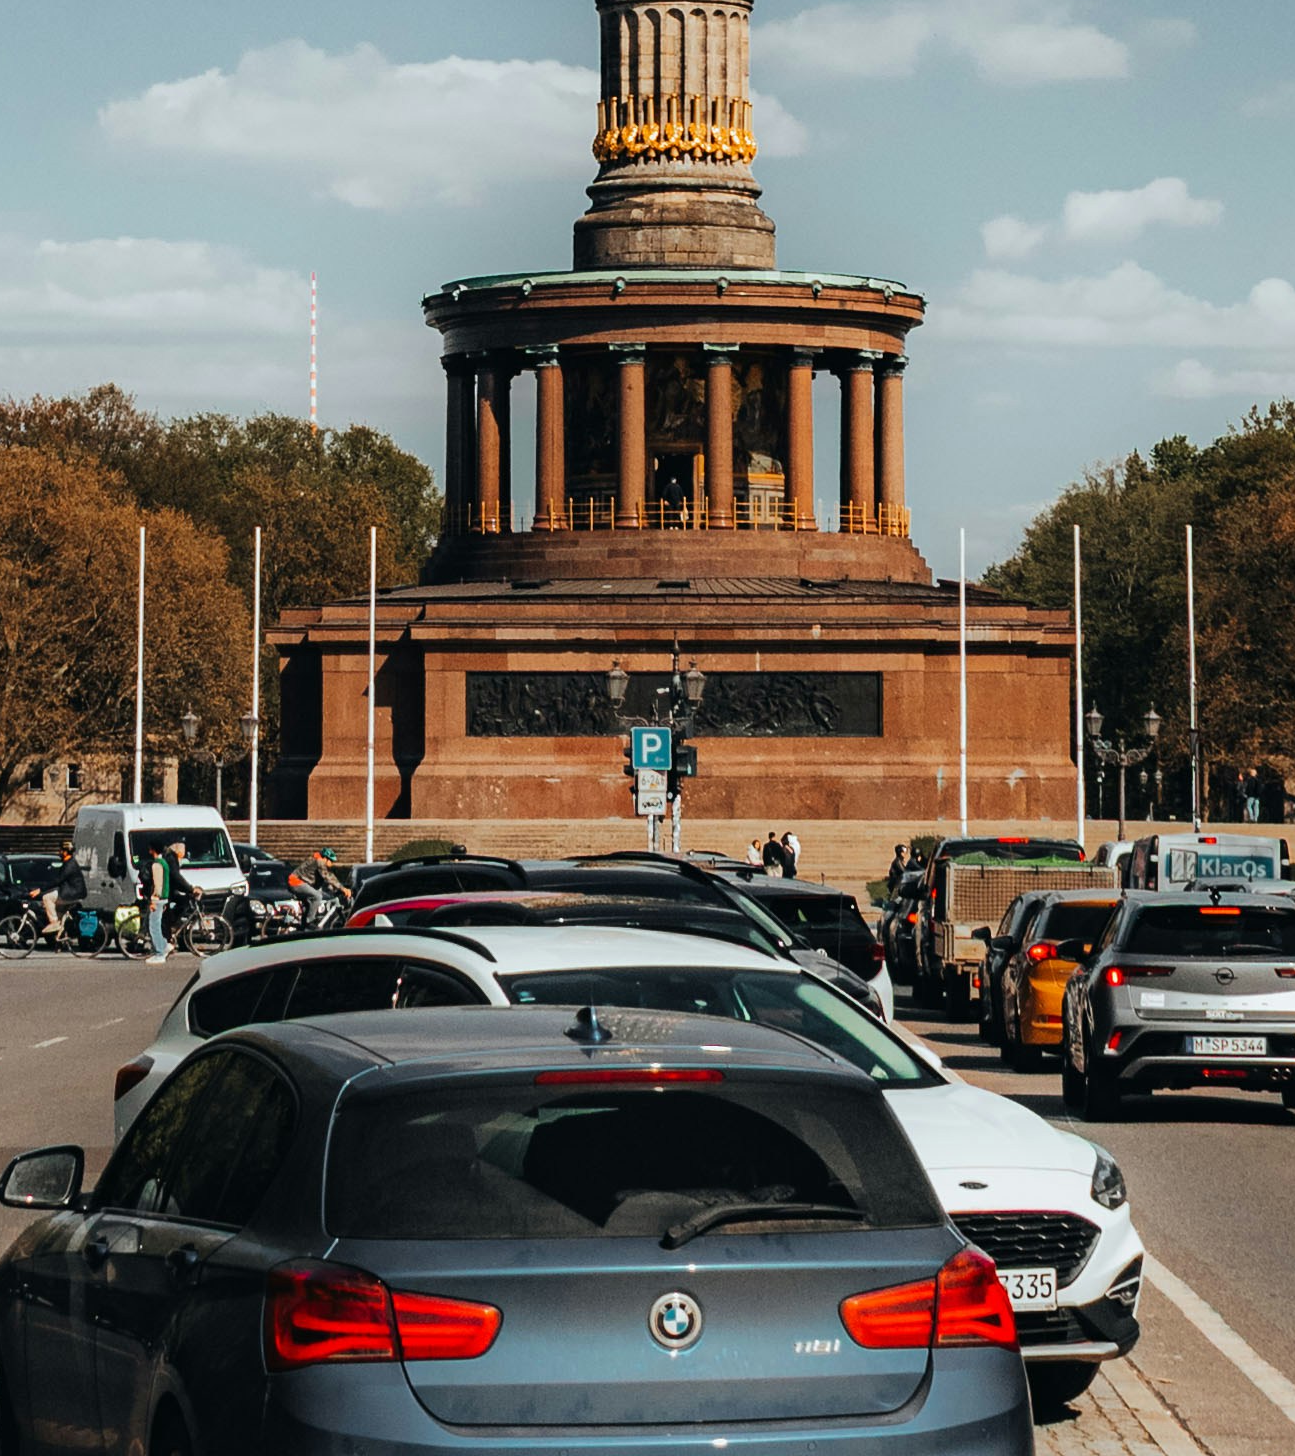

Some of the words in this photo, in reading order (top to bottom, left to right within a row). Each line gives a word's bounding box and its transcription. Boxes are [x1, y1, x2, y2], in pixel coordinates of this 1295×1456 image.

[642, 733, 662, 764] P
[1194, 1039, 1203, 1050] M
[1211, 1039, 1229, 1051] SP
[1231, 1039, 1264, 1052] 5344
